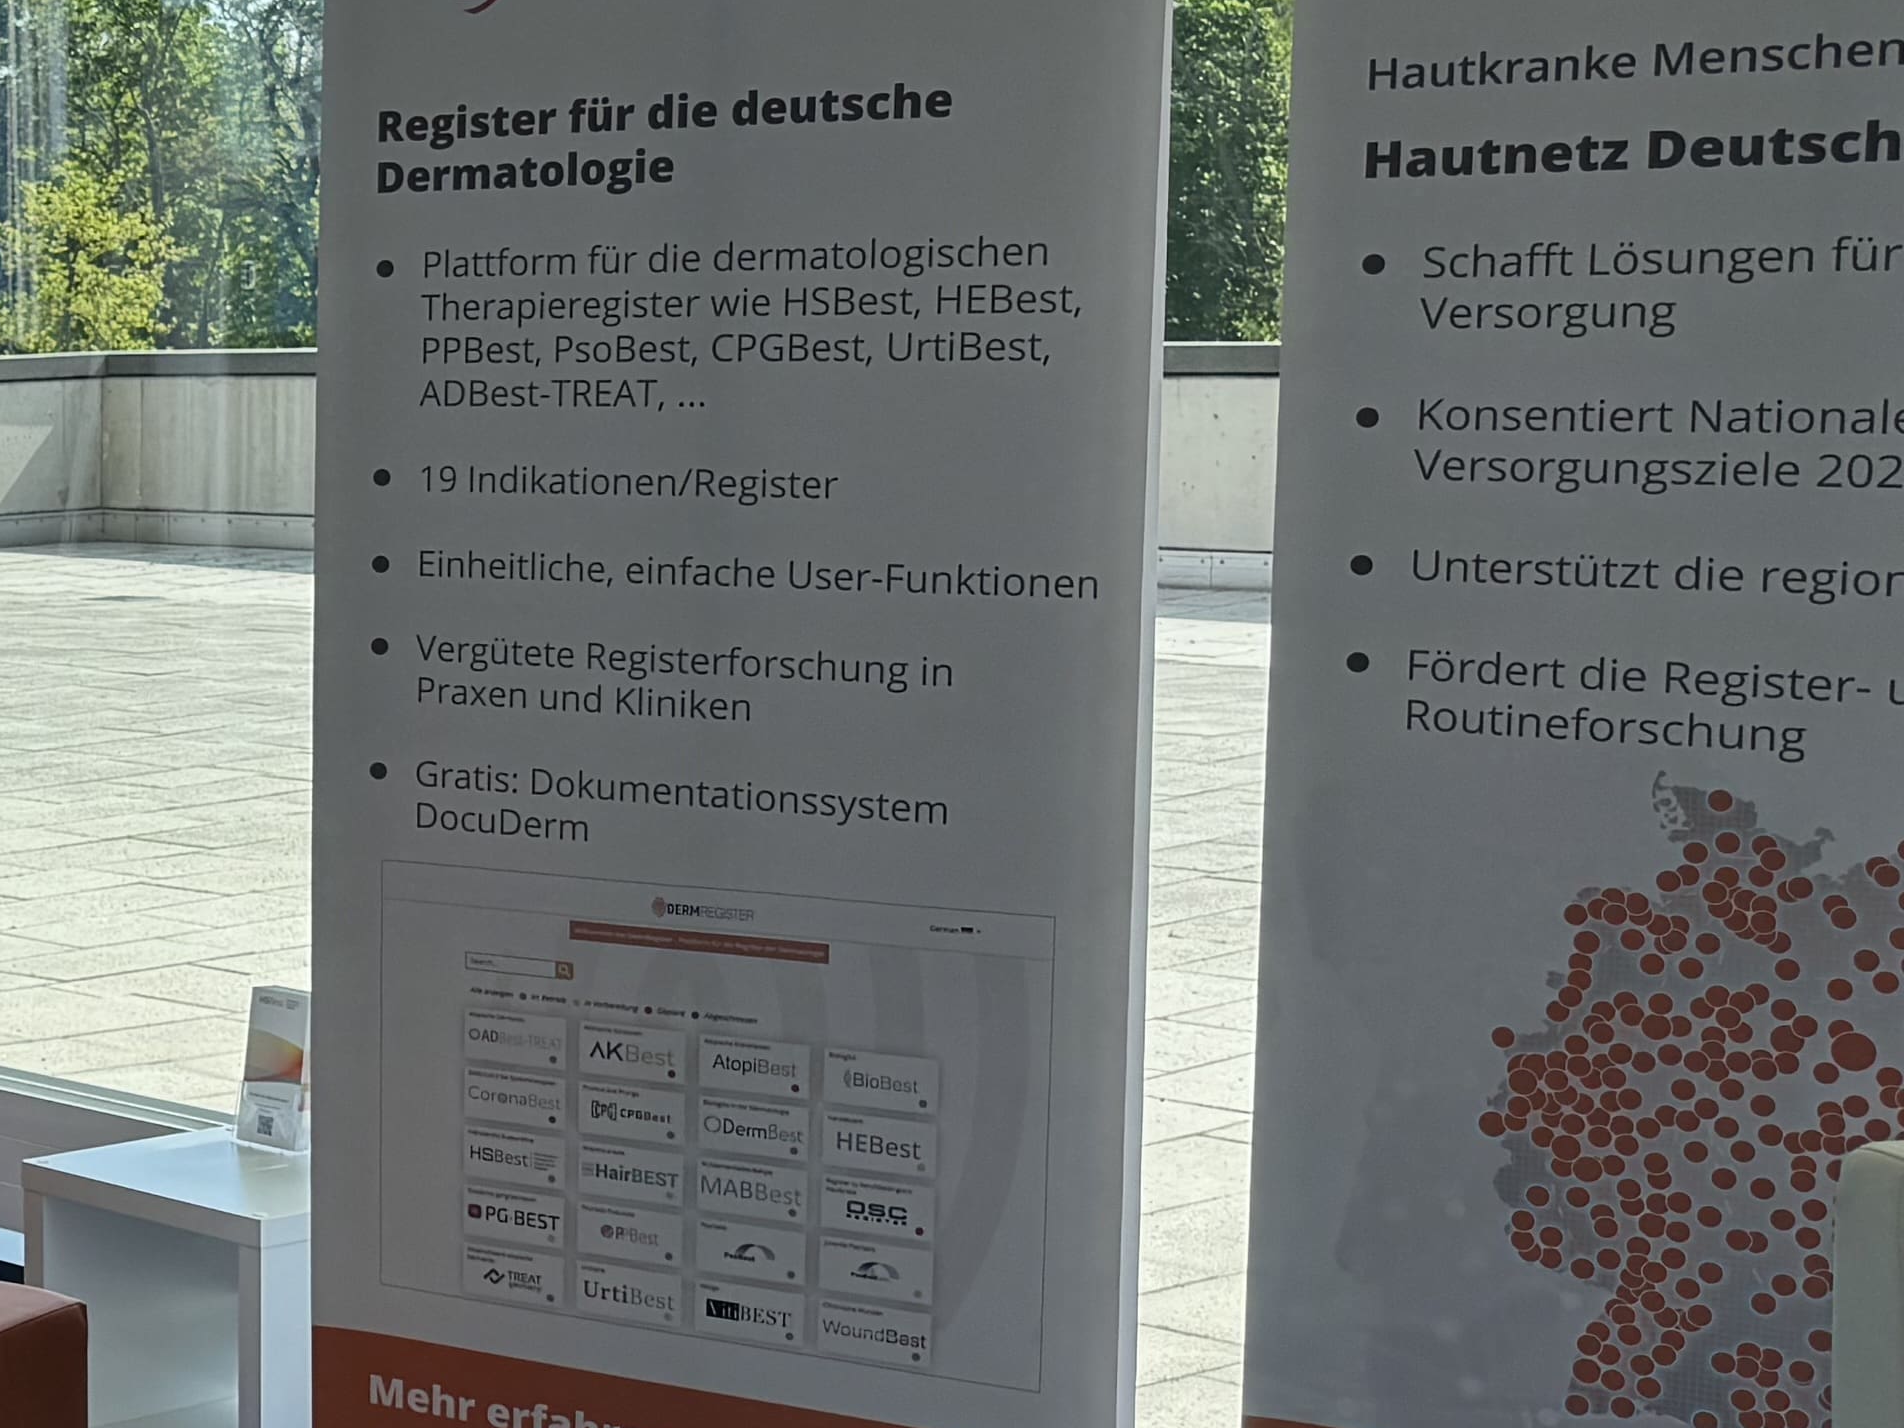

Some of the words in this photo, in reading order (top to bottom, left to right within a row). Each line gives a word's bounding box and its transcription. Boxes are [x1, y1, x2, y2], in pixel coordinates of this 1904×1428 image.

[1368, 47, 1636, 92] Hautkranke
[1654, 34, 1904, 78] Menschen
[377, 98, 557, 150] Register
[569, 97, 635, 132] für
[647, 91, 718, 129] die
[730, 82, 953, 128] deutsche
[377, 149, 674, 195] Dermatologie
[1365, 138, 1628, 179] Hautnetz
[423, 244, 577, 279] Plattform
[587, 245, 639, 276] für
[648, 242, 701, 273] die
[712, 234, 1049, 276] dermatologischen
[1423, 242, 1573, 278] Schafft
[1589, 240, 1815, 283] Lösungen
[1832, 235, 1904, 272] für
[421, 286, 701, 328] Therapieregister
[711, 287, 772, 318] wie
[783, 284, 922, 322] HSBest,
[935, 282, 1082, 319] HEBest,
[1421, 296, 1677, 338] Versorgung
[422, 333, 541, 370] PPBest,
[553, 331, 699, 368] PsoBest,
[711, 330, 873, 368] CPGBest,
[887, 328, 1051, 367] UrtiBest,
[420, 376, 665, 413] ADBest-TREAT,
[1418, 398, 1674, 434] Konsentiert
[420, 465, 457, 494] 19
[468, 465, 838, 506] Indikationen/Register
[1414, 448, 1800, 495] Versorgungsziele
[418, 550, 615, 589] Einheitliche,
[625, 555, 776, 589] einfache
[788, 560, 1099, 600] User-Funktionen
[1411, 549, 1659, 589] Unterstützt
[1675, 557, 1744, 593] die
[416, 634, 575, 672] Vergütete
[587, 641, 908, 693] Registerforschung
[921, 655, 954, 688] in
[1408, 649, 1565, 690] Fördert
[1580, 657, 1647, 692] die
[1664, 660, 1872, 707] Register-
[416, 676, 527, 710] Praxen
[539, 685, 602, 714] und
[615, 686, 751, 721] Kliniken
[1406, 699, 1807, 763] Routineforschung
[416, 761, 519, 796] Gratis:
[530, 766, 948, 826] Dokumentationssystem
[415, 803, 590, 842] DocuDerm
[837, 1132, 921, 1160] HEBest
[595, 1163, 678, 1188] HairBEST
[584, 1280, 674, 1310] UrtiBest
[368, 1375, 474, 1425] Mehr
